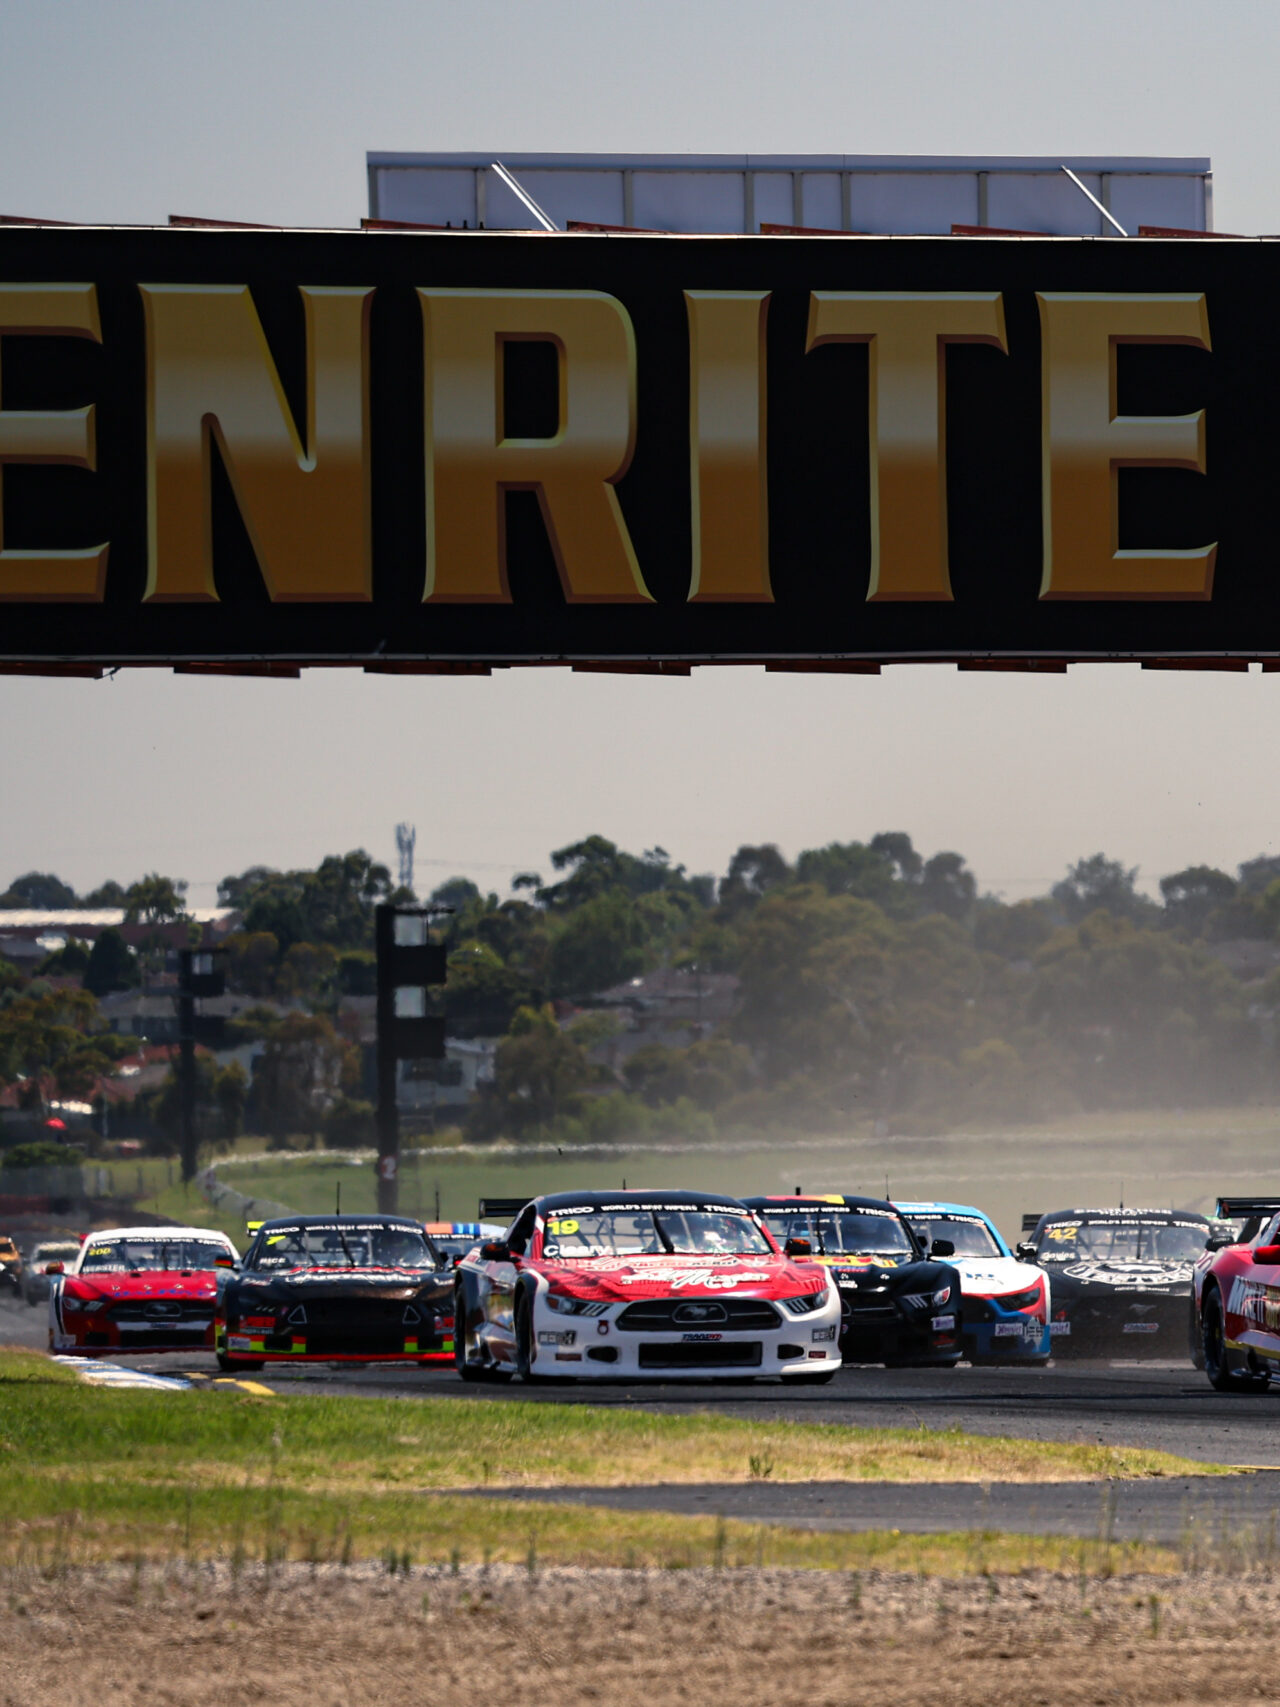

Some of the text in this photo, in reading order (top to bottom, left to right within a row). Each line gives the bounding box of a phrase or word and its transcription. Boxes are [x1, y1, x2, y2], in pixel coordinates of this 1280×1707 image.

[0, 283, 1218, 603] ENRITE
[548, 1206, 594, 1217] TRICO
[703, 1205, 748, 1215] TRICO
[856, 1207, 897, 1217] TRICO
[947, 1214, 985, 1224] TRICO
[1045, 1220, 1084, 1229] TRICO
[1172, 1220, 1209, 1229] TRICO
[264, 1226, 300, 1235] TRICO
[547, 1219, 579, 1235] 19
[1048, 1227, 1078, 1240] 42
